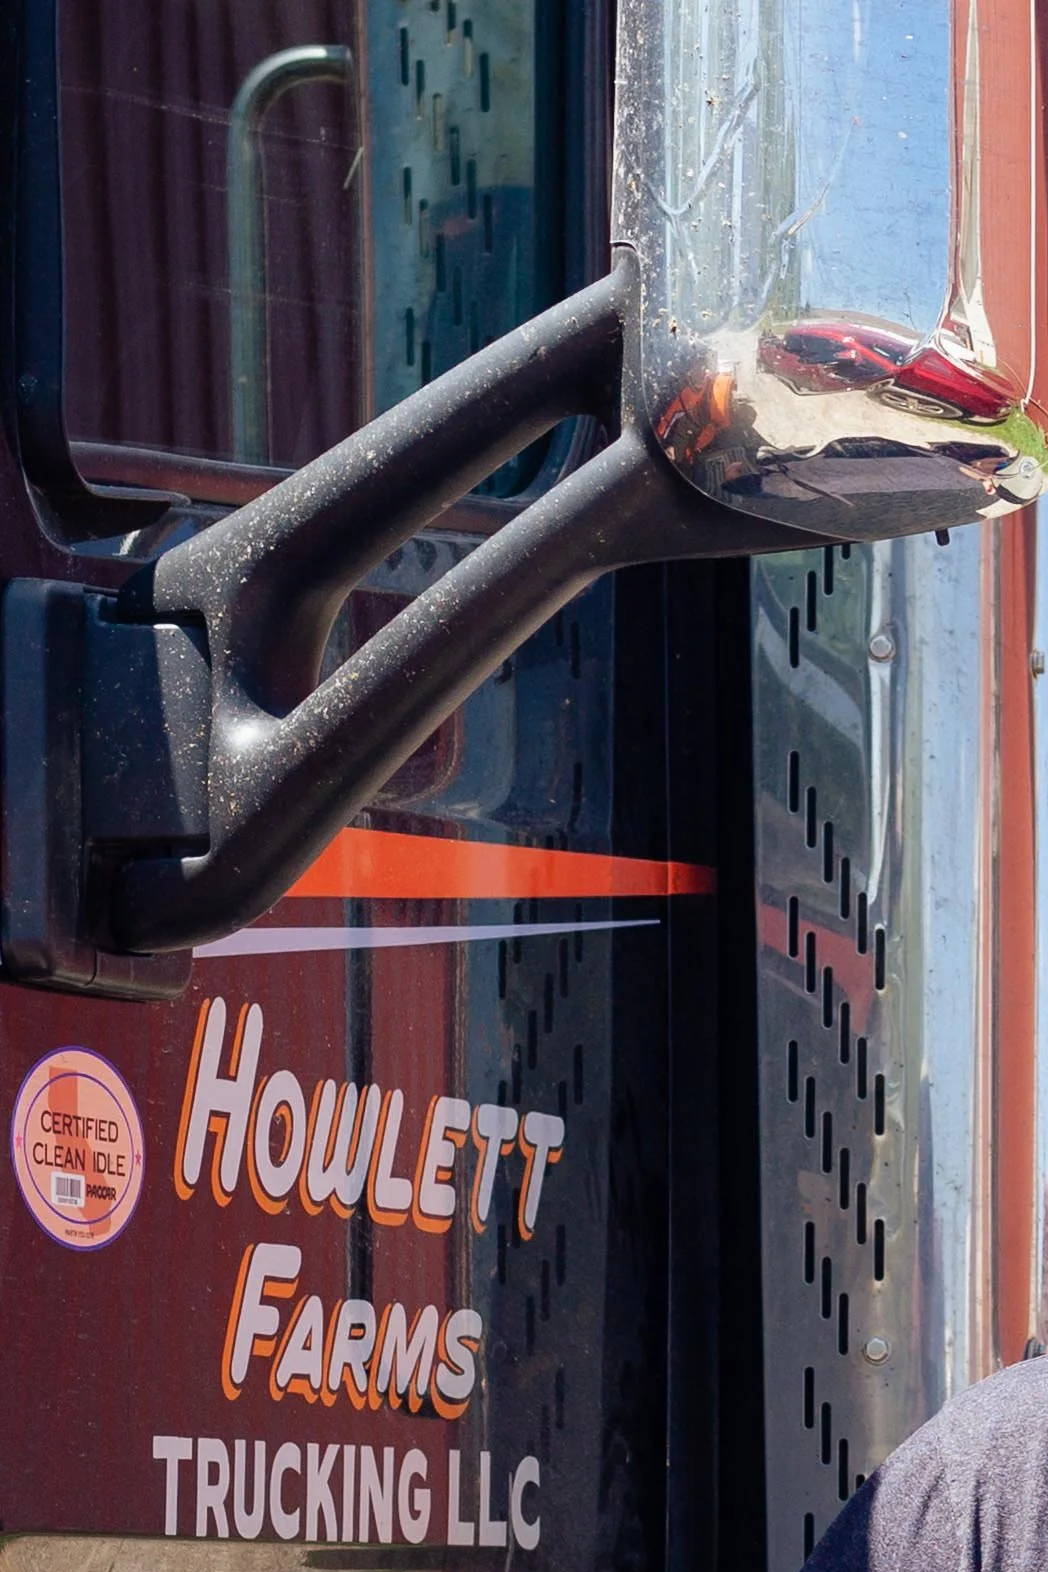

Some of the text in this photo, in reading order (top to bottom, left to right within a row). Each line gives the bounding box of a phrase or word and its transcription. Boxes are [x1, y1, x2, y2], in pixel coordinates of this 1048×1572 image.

[34, 1143, 126, 1177] CLEAN IDLE
[41, 1110, 119, 1143] CERTIFIED
[175, 996, 565, 1239] HOWLETT
[222, 1243, 484, 1419] FARMS
[152, 1435, 541, 1551] TRUCKING LLC
